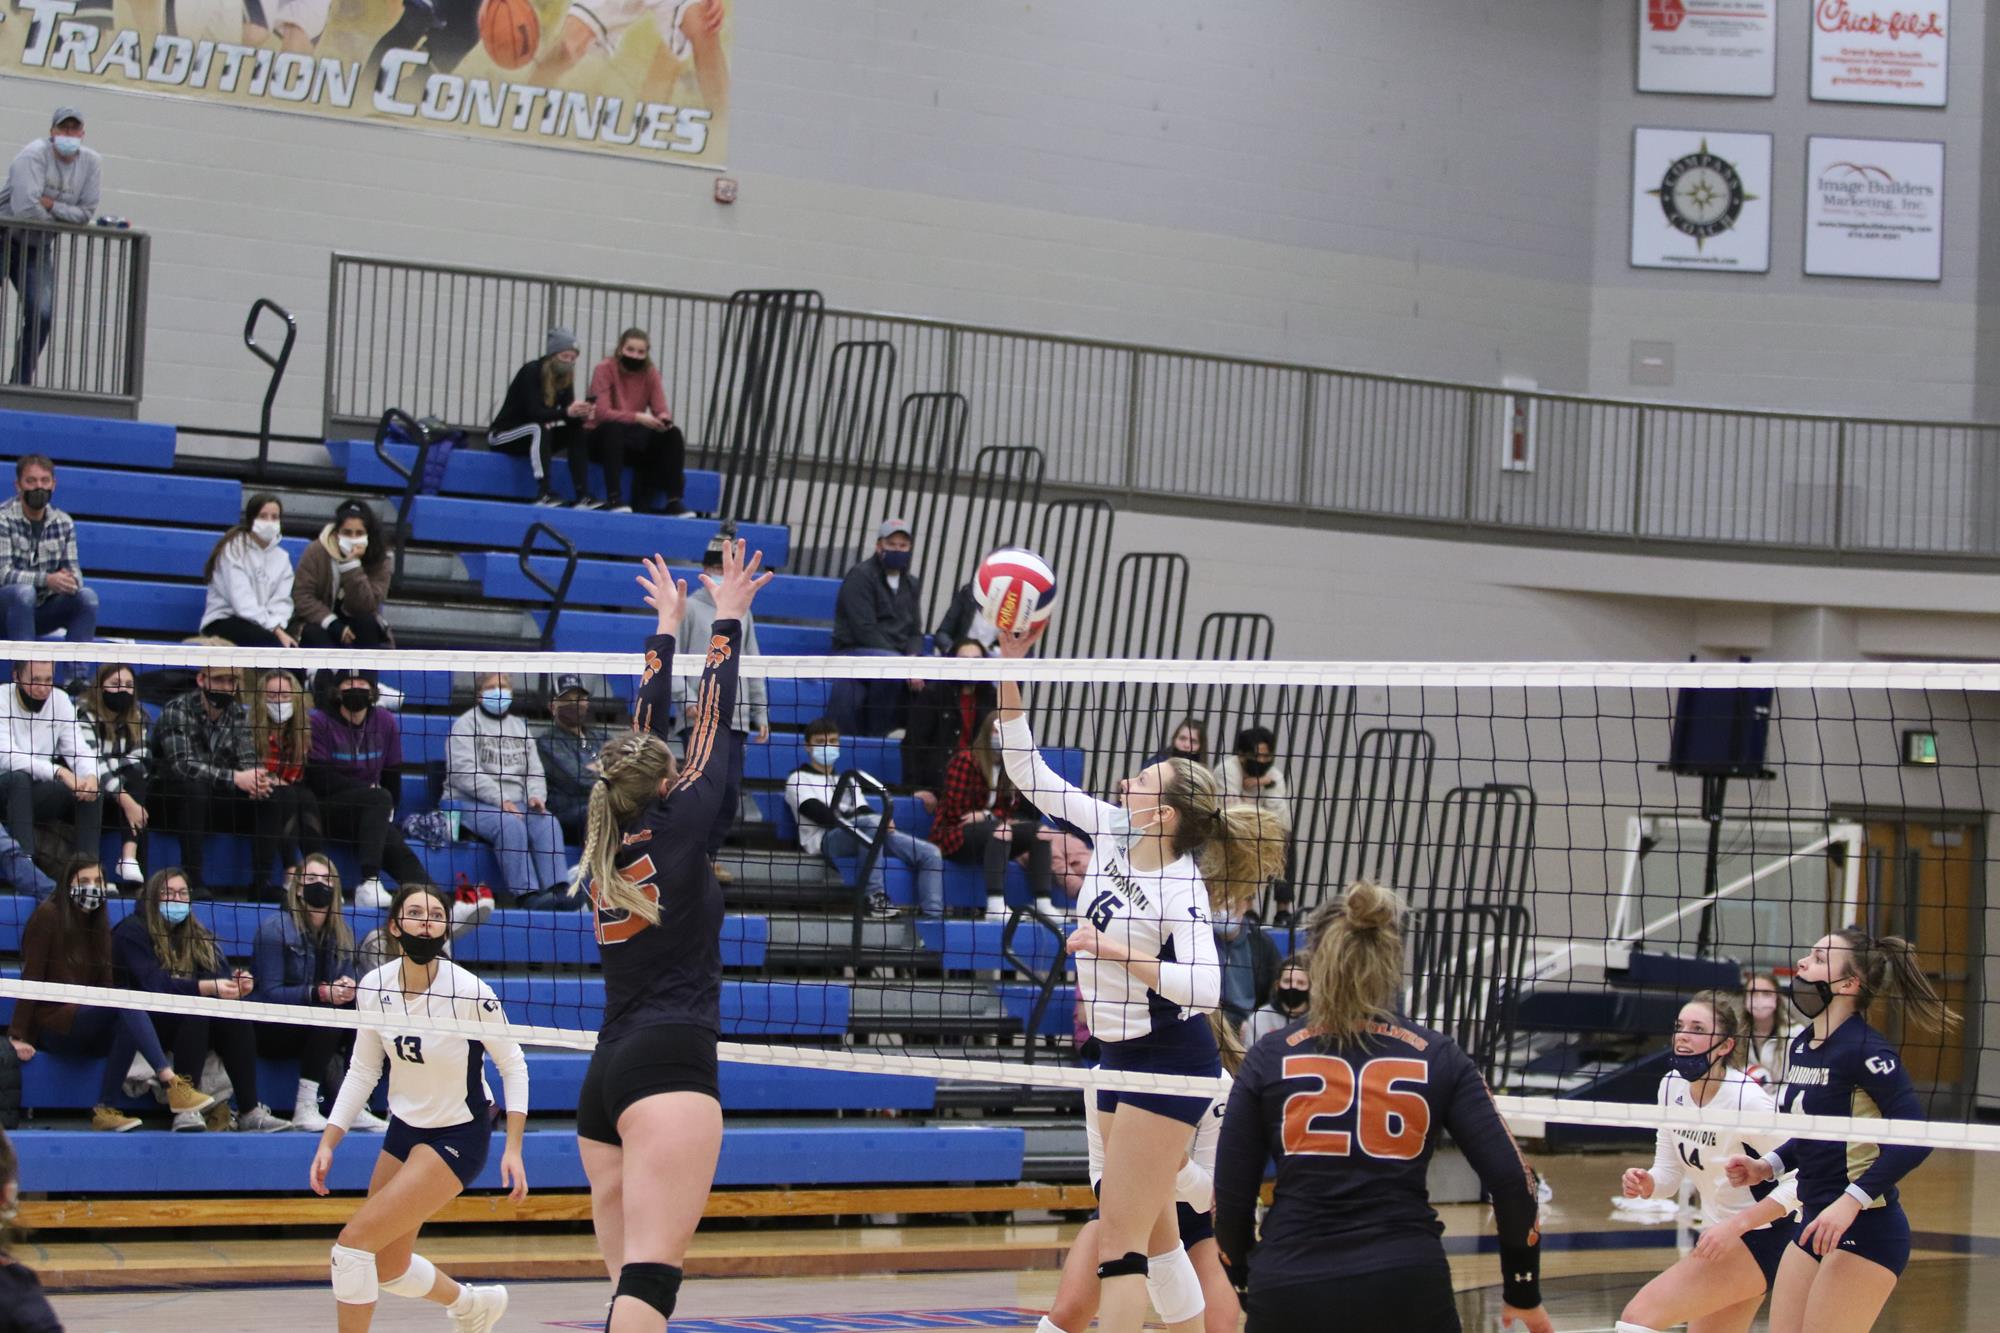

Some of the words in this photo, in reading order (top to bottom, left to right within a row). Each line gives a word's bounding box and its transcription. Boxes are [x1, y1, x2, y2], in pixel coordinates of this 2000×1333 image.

[19, 0, 361, 108] TRADITION
[373, 47, 713, 154] CONTINUES
[1818, 178, 1864, 194] Image
[1868, 180, 1934, 196] Builders
[1085, 890, 1124, 934] 15
[393, 1035, 425, 1065] 13
[1864, 1055, 1896, 1075] CU
[1281, 1054, 1431, 1161] 26
[1678, 1142, 1705, 1171] 14
